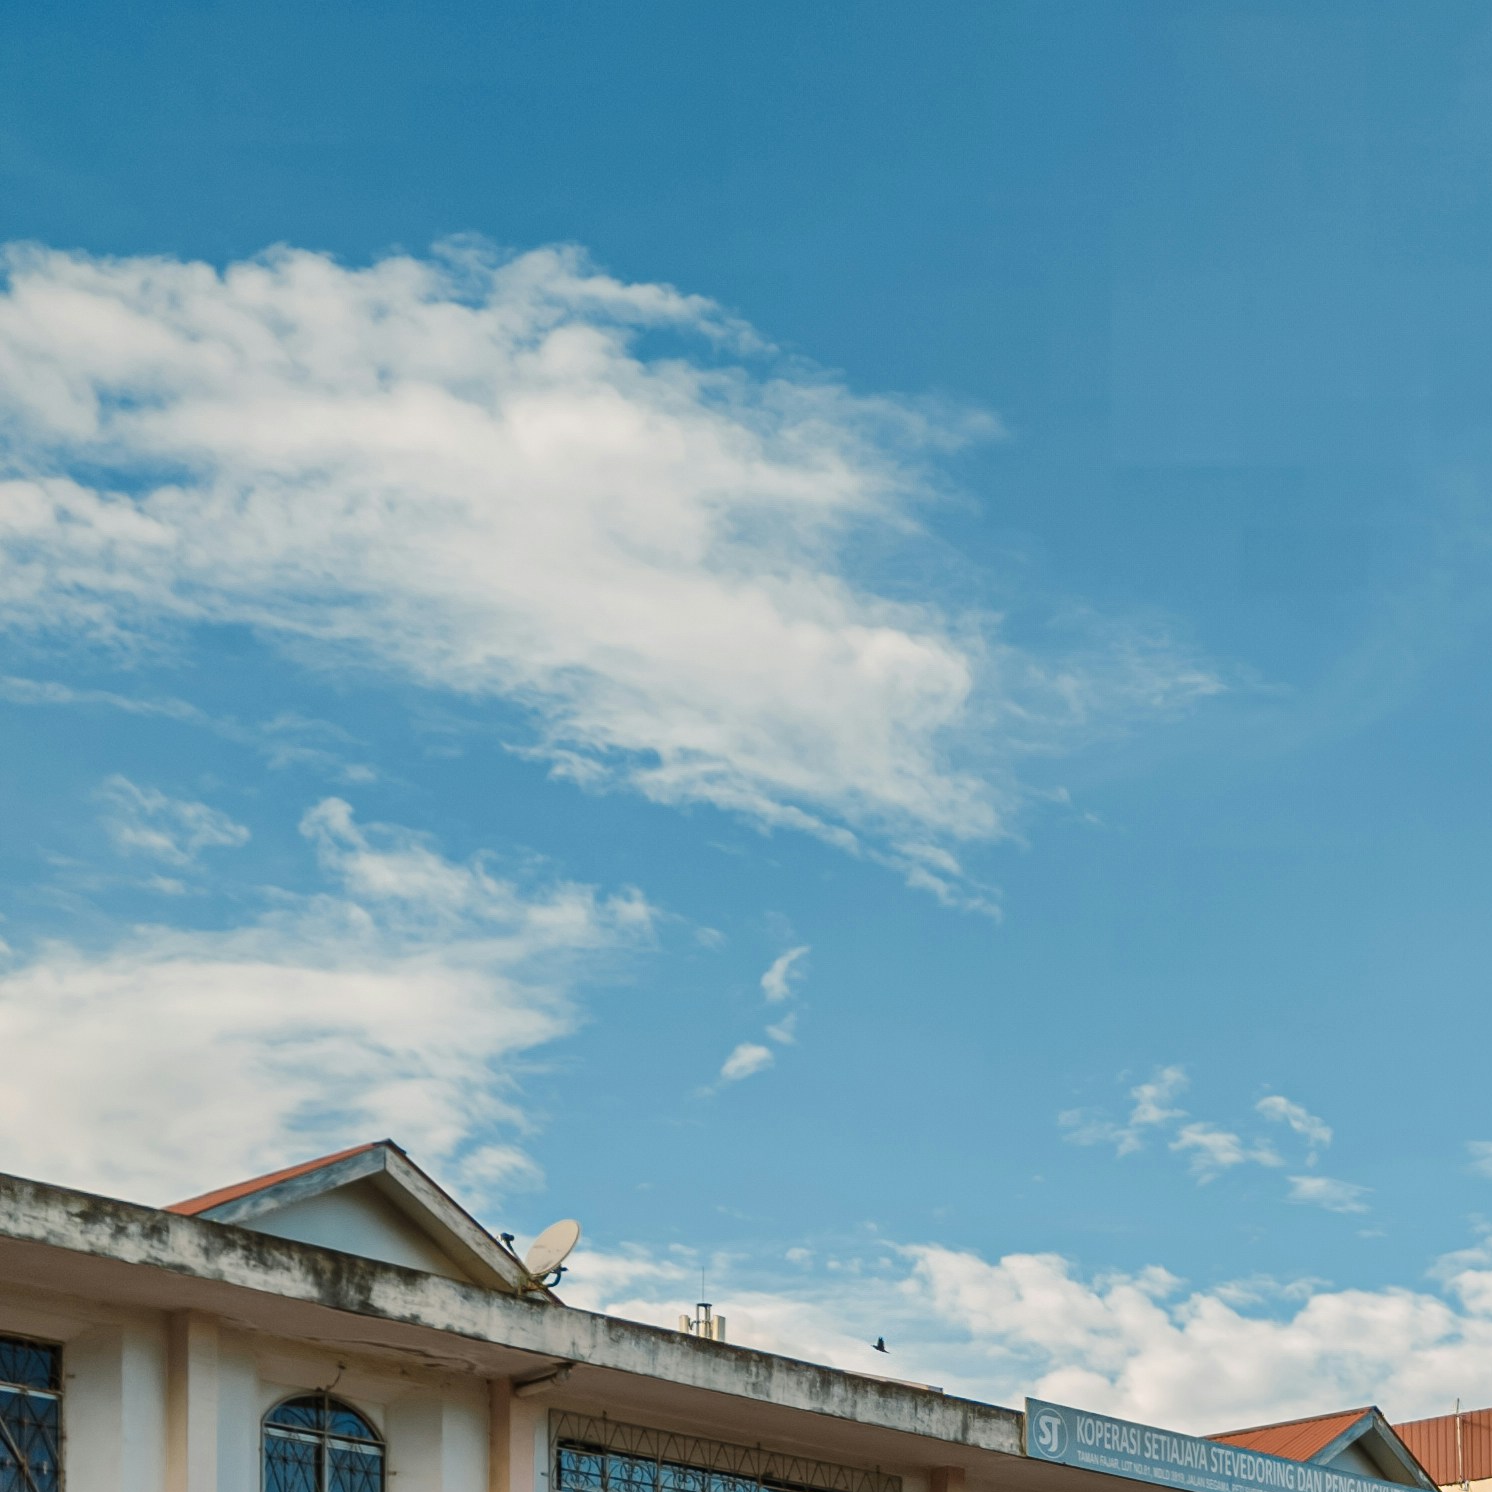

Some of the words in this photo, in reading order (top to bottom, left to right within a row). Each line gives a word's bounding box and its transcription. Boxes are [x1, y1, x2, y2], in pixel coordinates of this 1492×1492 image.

[1076, 1415, 1141, 1455] KOPERASI
[1144, 1431, 1208, 1471] SETIAJAYA
[1210, 1446, 1294, 1490] STEVEDORING
[1077, 1450, 1099, 1465] TAMAN
